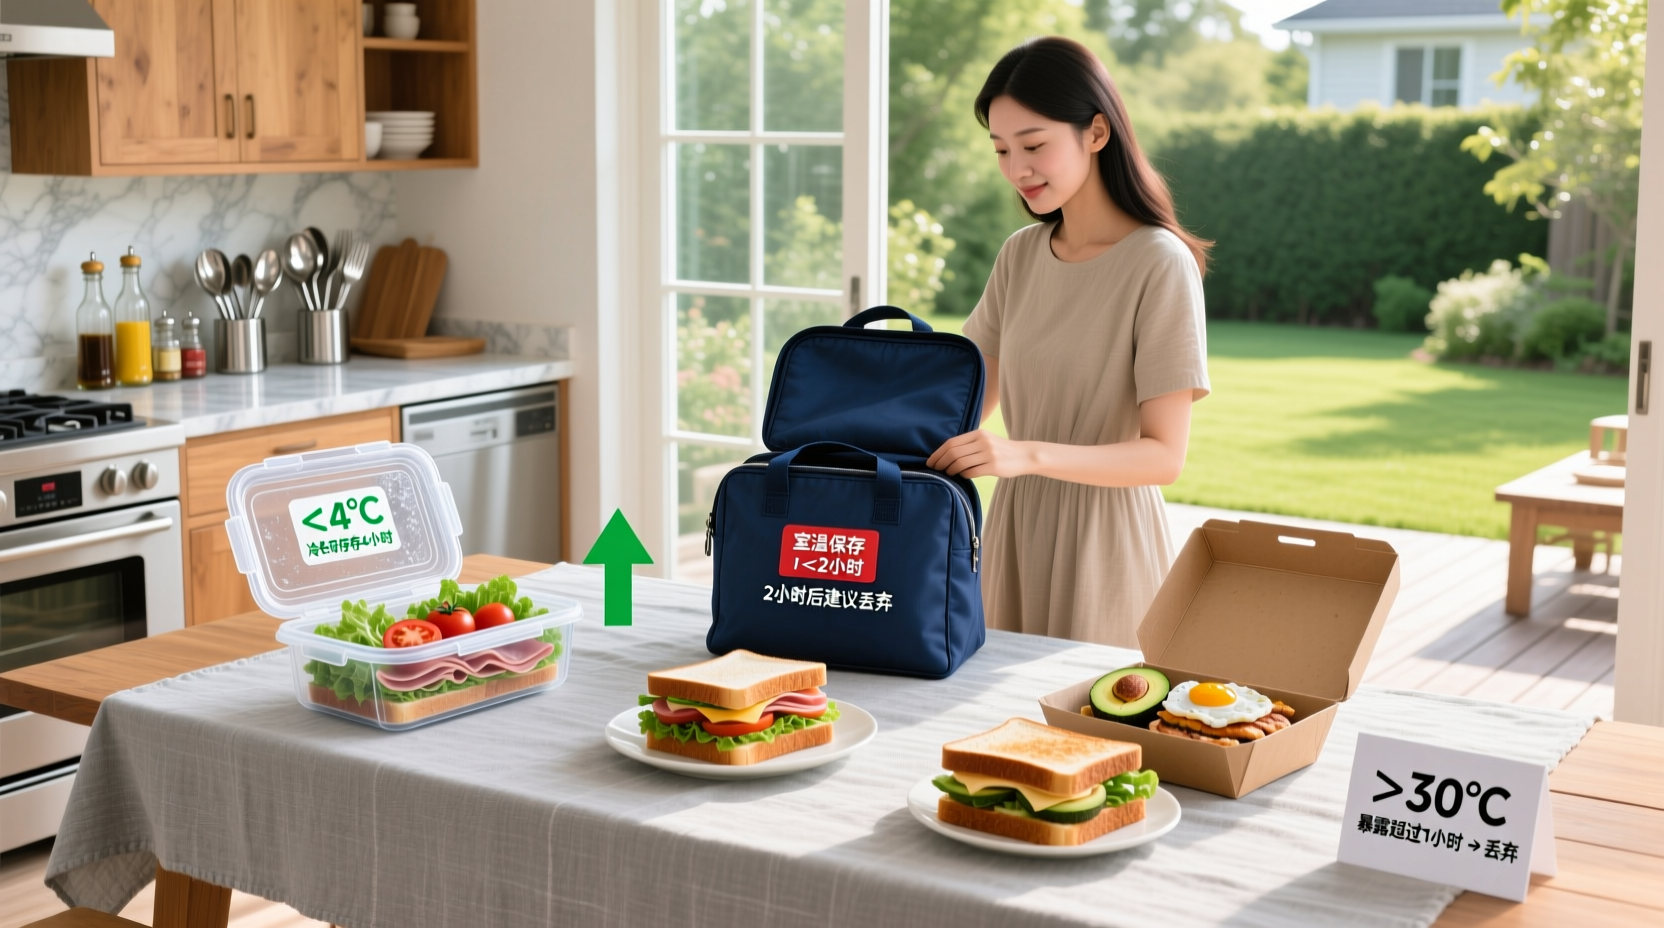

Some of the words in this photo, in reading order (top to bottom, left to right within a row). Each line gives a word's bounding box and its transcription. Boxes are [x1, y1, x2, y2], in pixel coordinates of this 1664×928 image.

[302, 495, 384, 531] <4°C
[792, 532, 866, 556] 室温保存
[763, 583, 893, 612] 2小时后建议丢弃
[1372, 769, 1512, 827] >30°C
[1484, 839, 1519, 864] 丢弃
